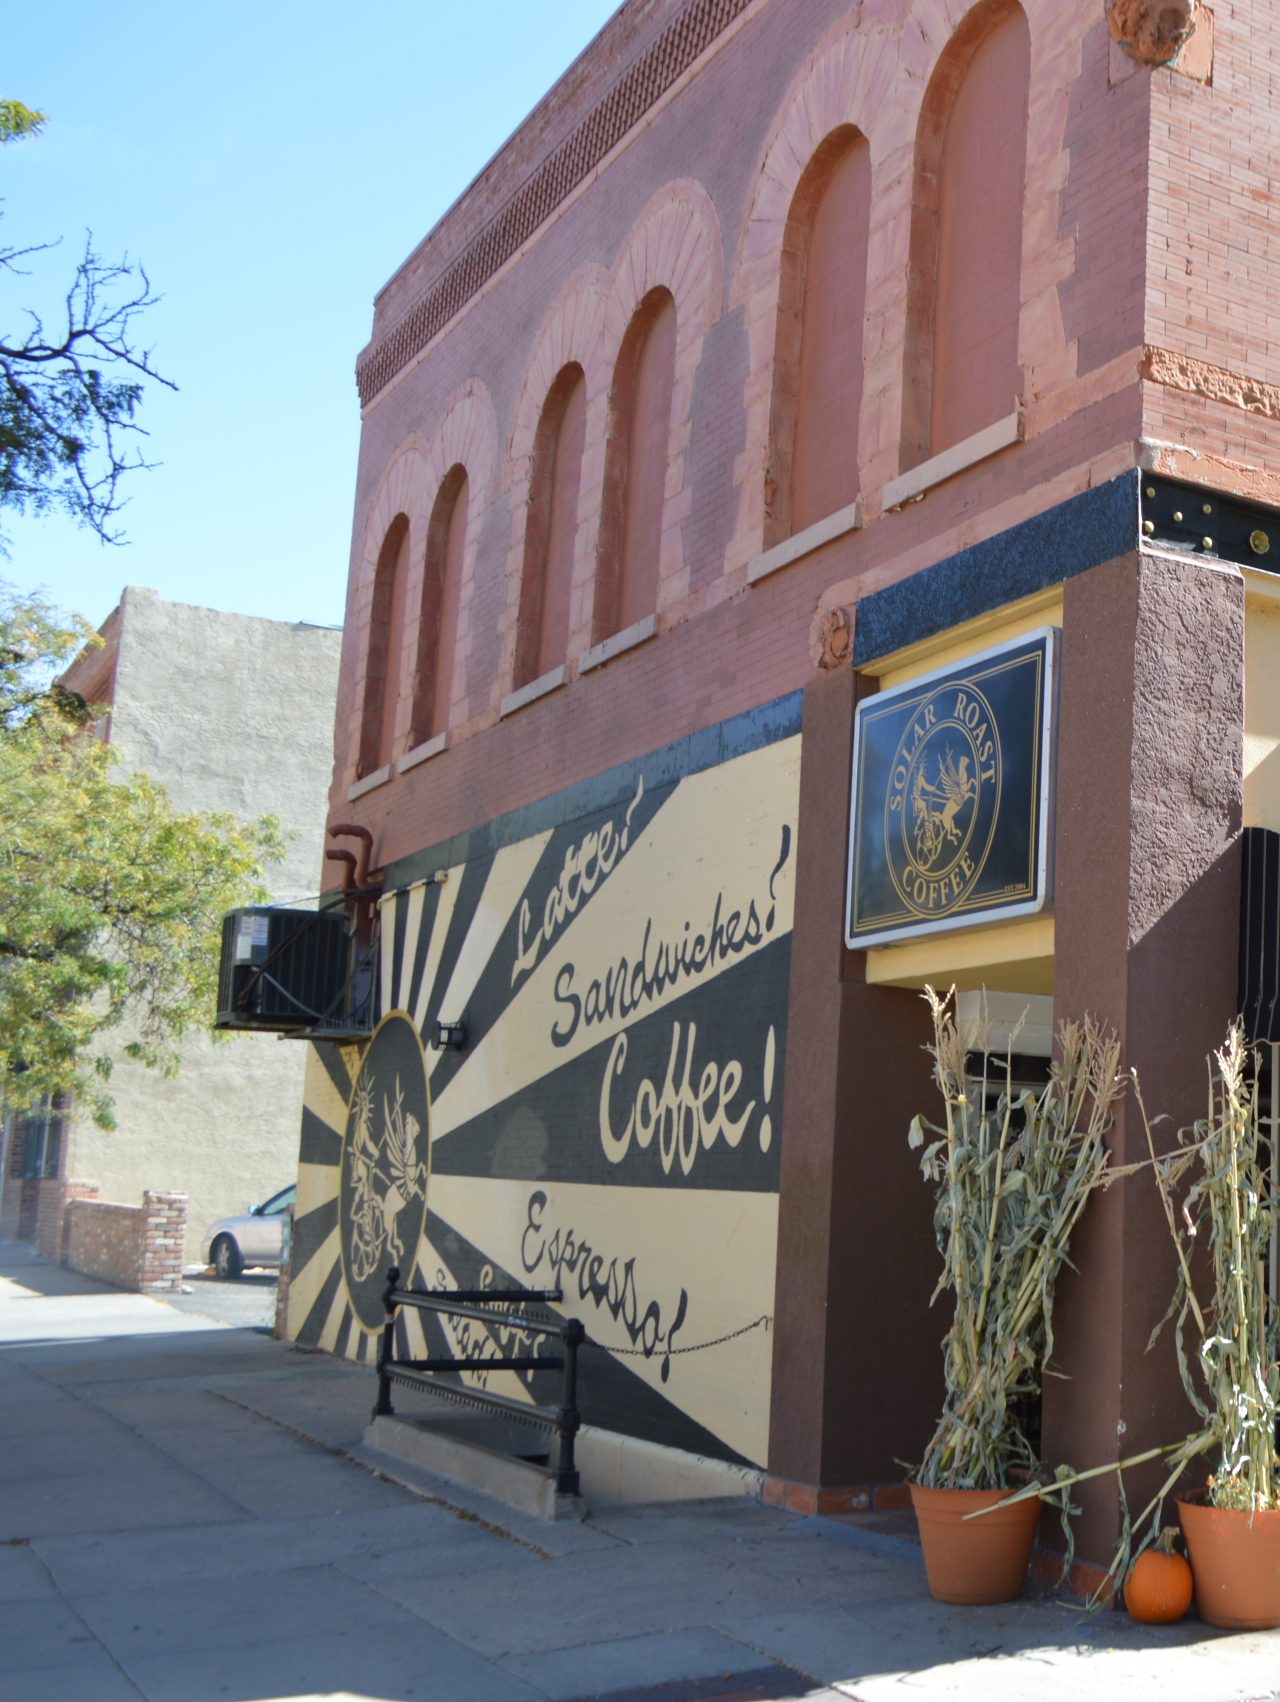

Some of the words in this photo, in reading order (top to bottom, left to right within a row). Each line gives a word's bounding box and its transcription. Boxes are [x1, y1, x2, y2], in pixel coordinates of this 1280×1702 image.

[890, 704, 936, 812] SOLAR
[953, 692, 996, 785] ROAST
[510, 773, 644, 988] Latte!
[550, 824, 792, 1049] Sandwiches!
[902, 851, 975, 908] COFFEE
[600, 1020, 776, 1176] Coffee!
[521, 1189, 690, 1384] Espresso!
